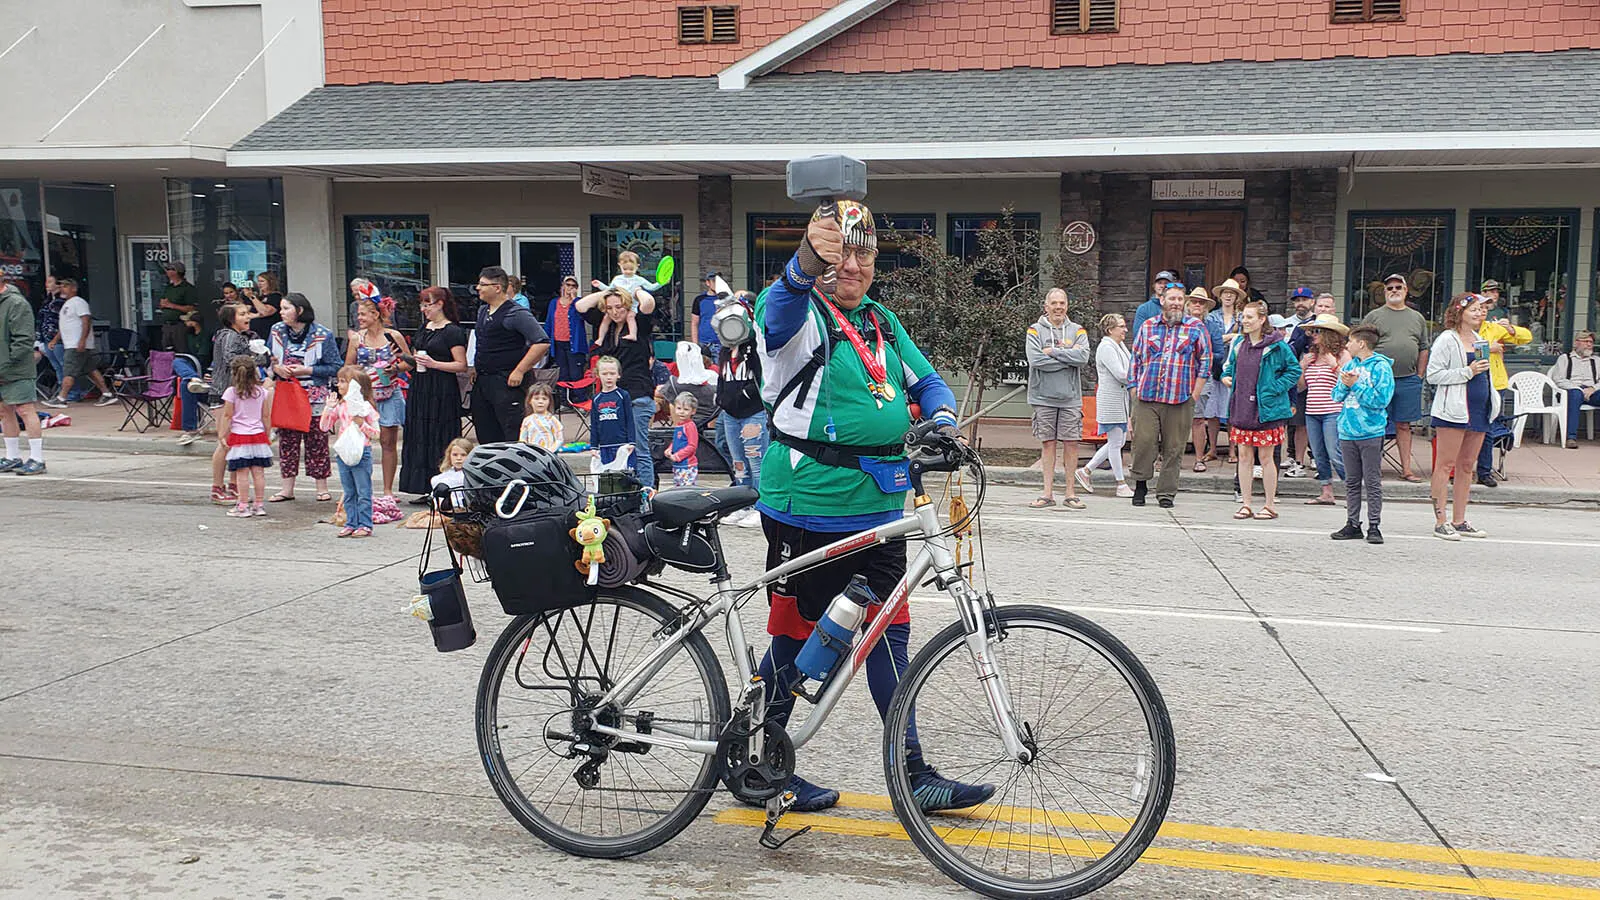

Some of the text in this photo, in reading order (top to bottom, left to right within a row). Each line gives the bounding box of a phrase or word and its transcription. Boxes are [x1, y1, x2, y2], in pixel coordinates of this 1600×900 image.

[1208, 181, 1243, 198] House
[145, 249, 168, 261] 378
[885, 583, 907, 615] GIANT
